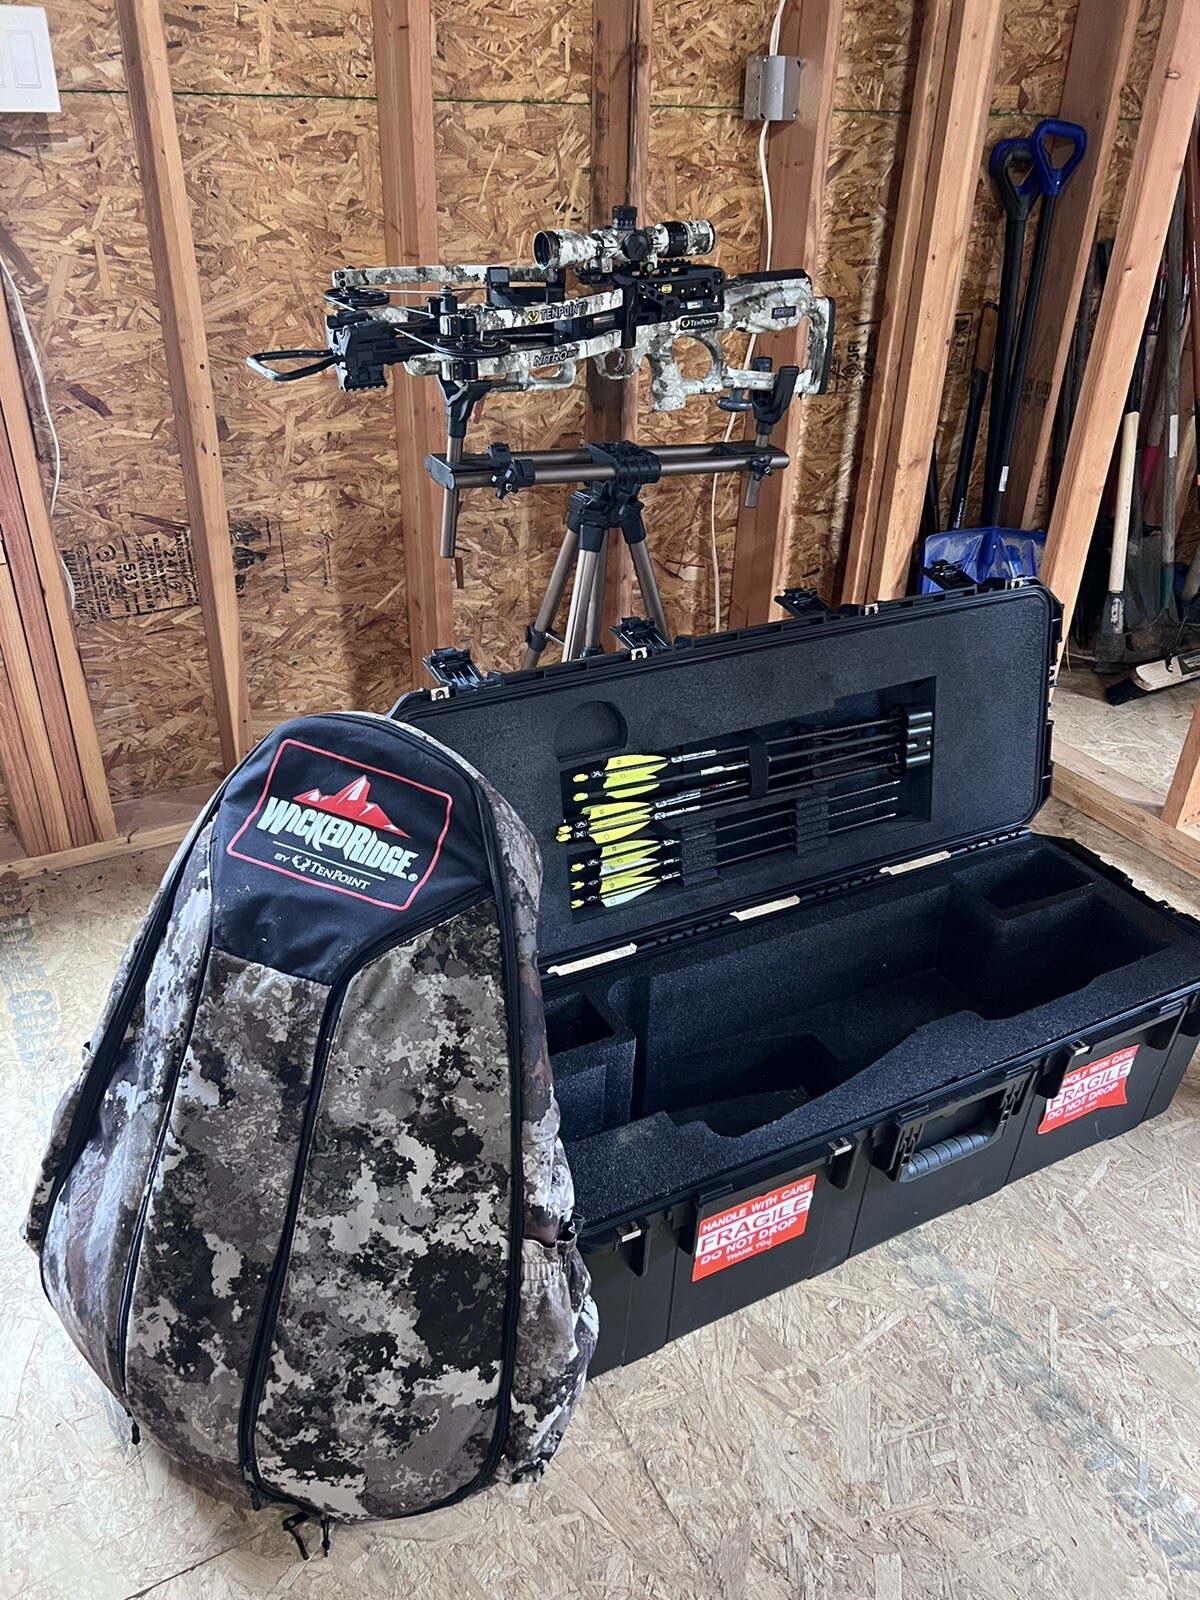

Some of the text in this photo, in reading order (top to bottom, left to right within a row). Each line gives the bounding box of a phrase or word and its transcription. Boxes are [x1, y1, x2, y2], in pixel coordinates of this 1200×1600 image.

[541, 303, 583, 321] TENPOINT
[532, 350, 568, 367] NITRO
[273, 852, 371, 891] BY TENPOINT
[1049, 1061, 1131, 1110] FRAGILE
[1062, 1048, 1136, 1087] NDLE WITH CARE
[1047, 1081, 1119, 1121] DO NOT DROP
[700, 1194, 810, 1253] FRAGILE
[702, 1180, 812, 1234] HANDLE WITH CARE
[700, 1216, 798, 1266] DO NOT DROP
[726, 1237, 773, 1262] THANK YOU
